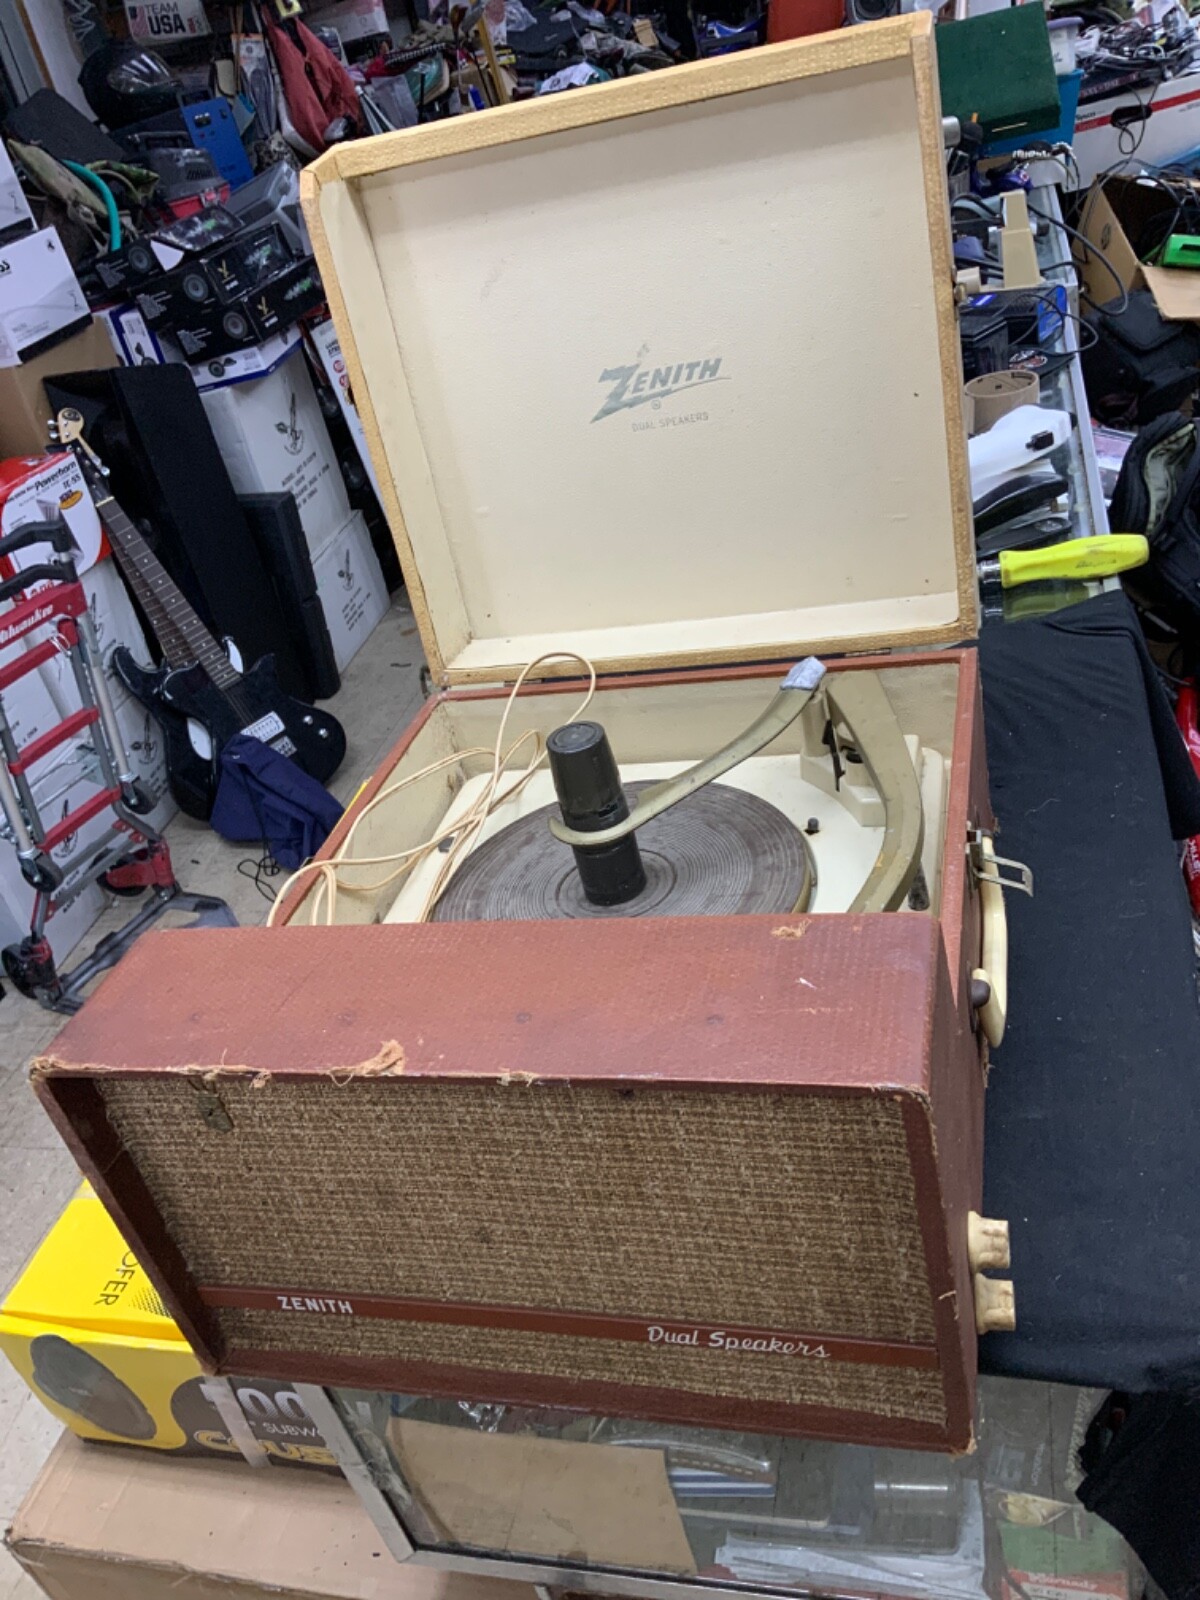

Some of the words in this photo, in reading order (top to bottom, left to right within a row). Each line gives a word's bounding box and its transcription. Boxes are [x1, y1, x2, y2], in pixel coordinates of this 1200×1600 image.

[144, 2, 179, 15] TEAM
[147, 13, 187, 35] USA
[590, 357, 728, 424] ZENITH
[631, 422, 657, 432] DUAL
[659, 411, 709, 429] SPEAKERS
[276, 1296, 353, 1314] ZENITH
[647, 1326, 700, 1346] Dual
[708, 1331, 831, 1359] Speakers
[262, 1421, 323, 1438] SUBW
